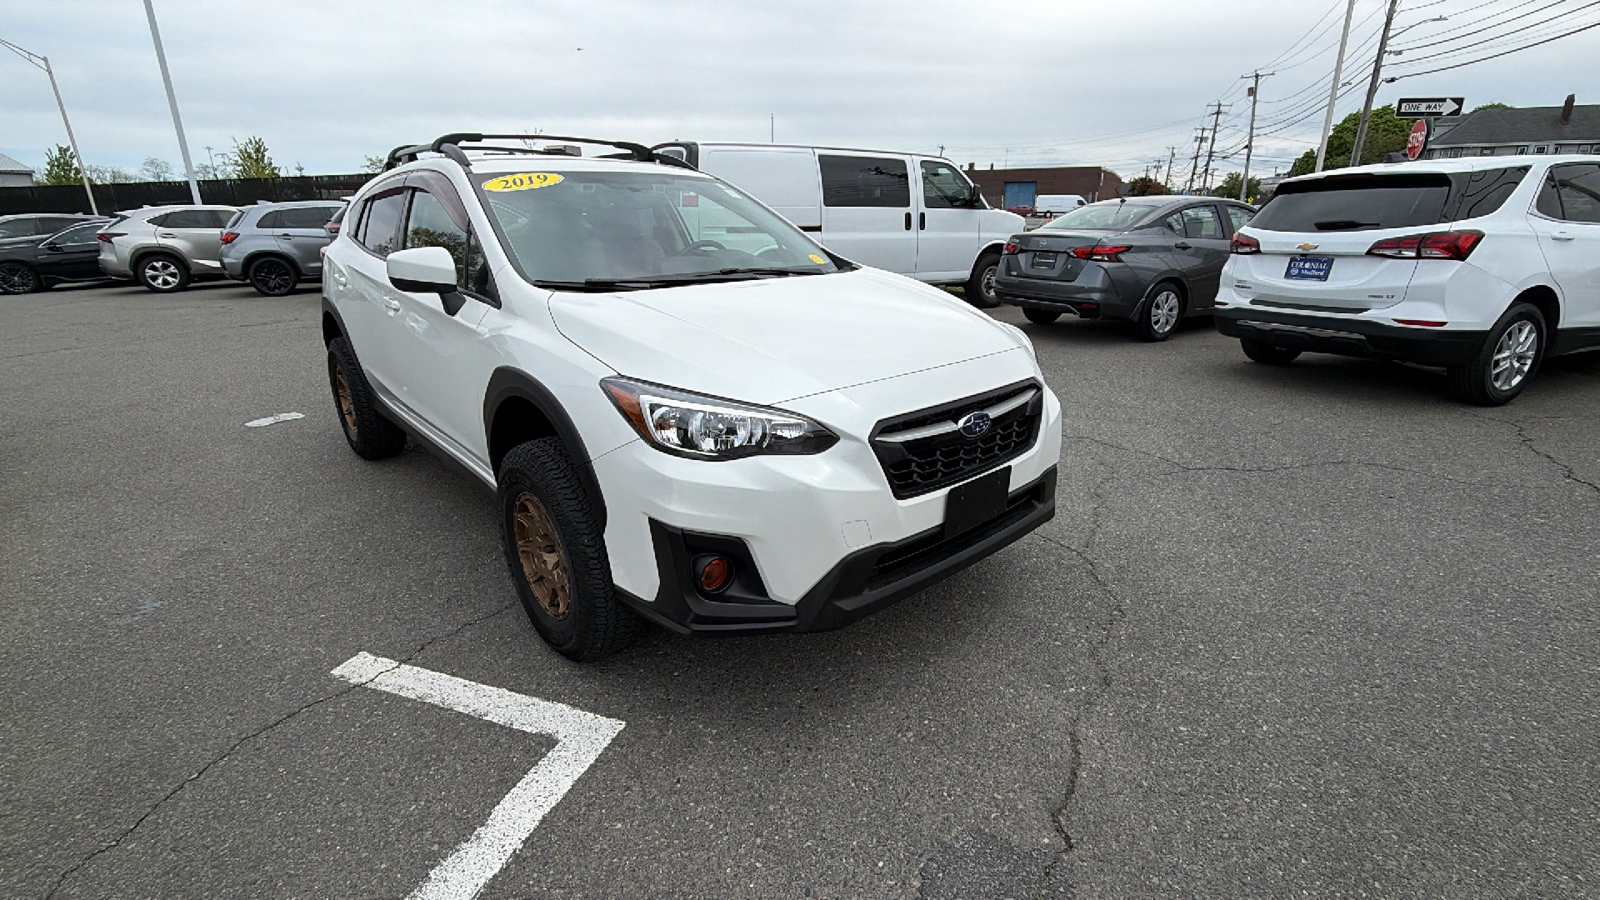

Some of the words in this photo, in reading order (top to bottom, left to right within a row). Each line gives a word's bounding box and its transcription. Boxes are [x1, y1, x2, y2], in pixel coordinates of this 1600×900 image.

[1404, 103, 1422, 111] ONE
[1424, 103, 1444, 111] WAY
[1408, 131, 1424, 147] STOP
[498, 173, 548, 189] 2019
